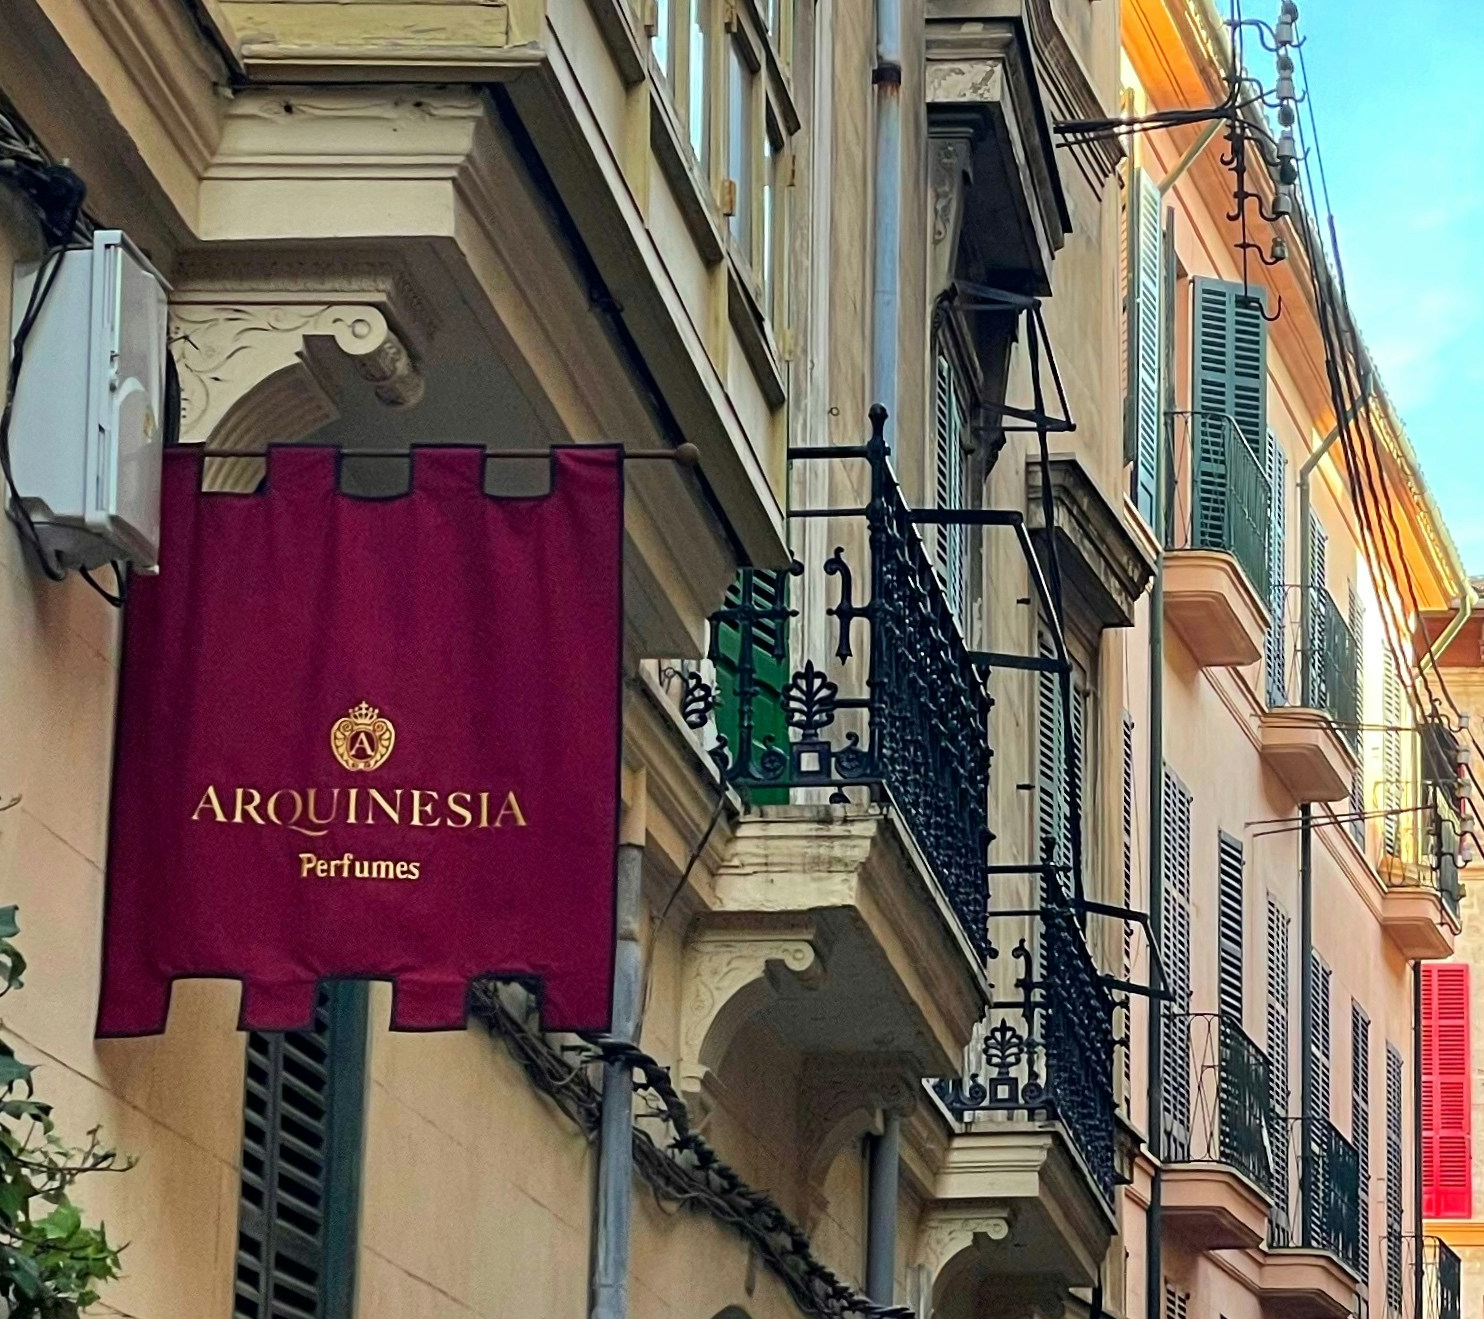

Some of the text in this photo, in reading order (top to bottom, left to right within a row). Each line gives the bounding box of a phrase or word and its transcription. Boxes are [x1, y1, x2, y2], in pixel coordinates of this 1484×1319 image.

[350, 731, 375, 757] A
[191, 784, 528, 836] ARQUINESIA
[298, 852, 421, 881] Perfumes
